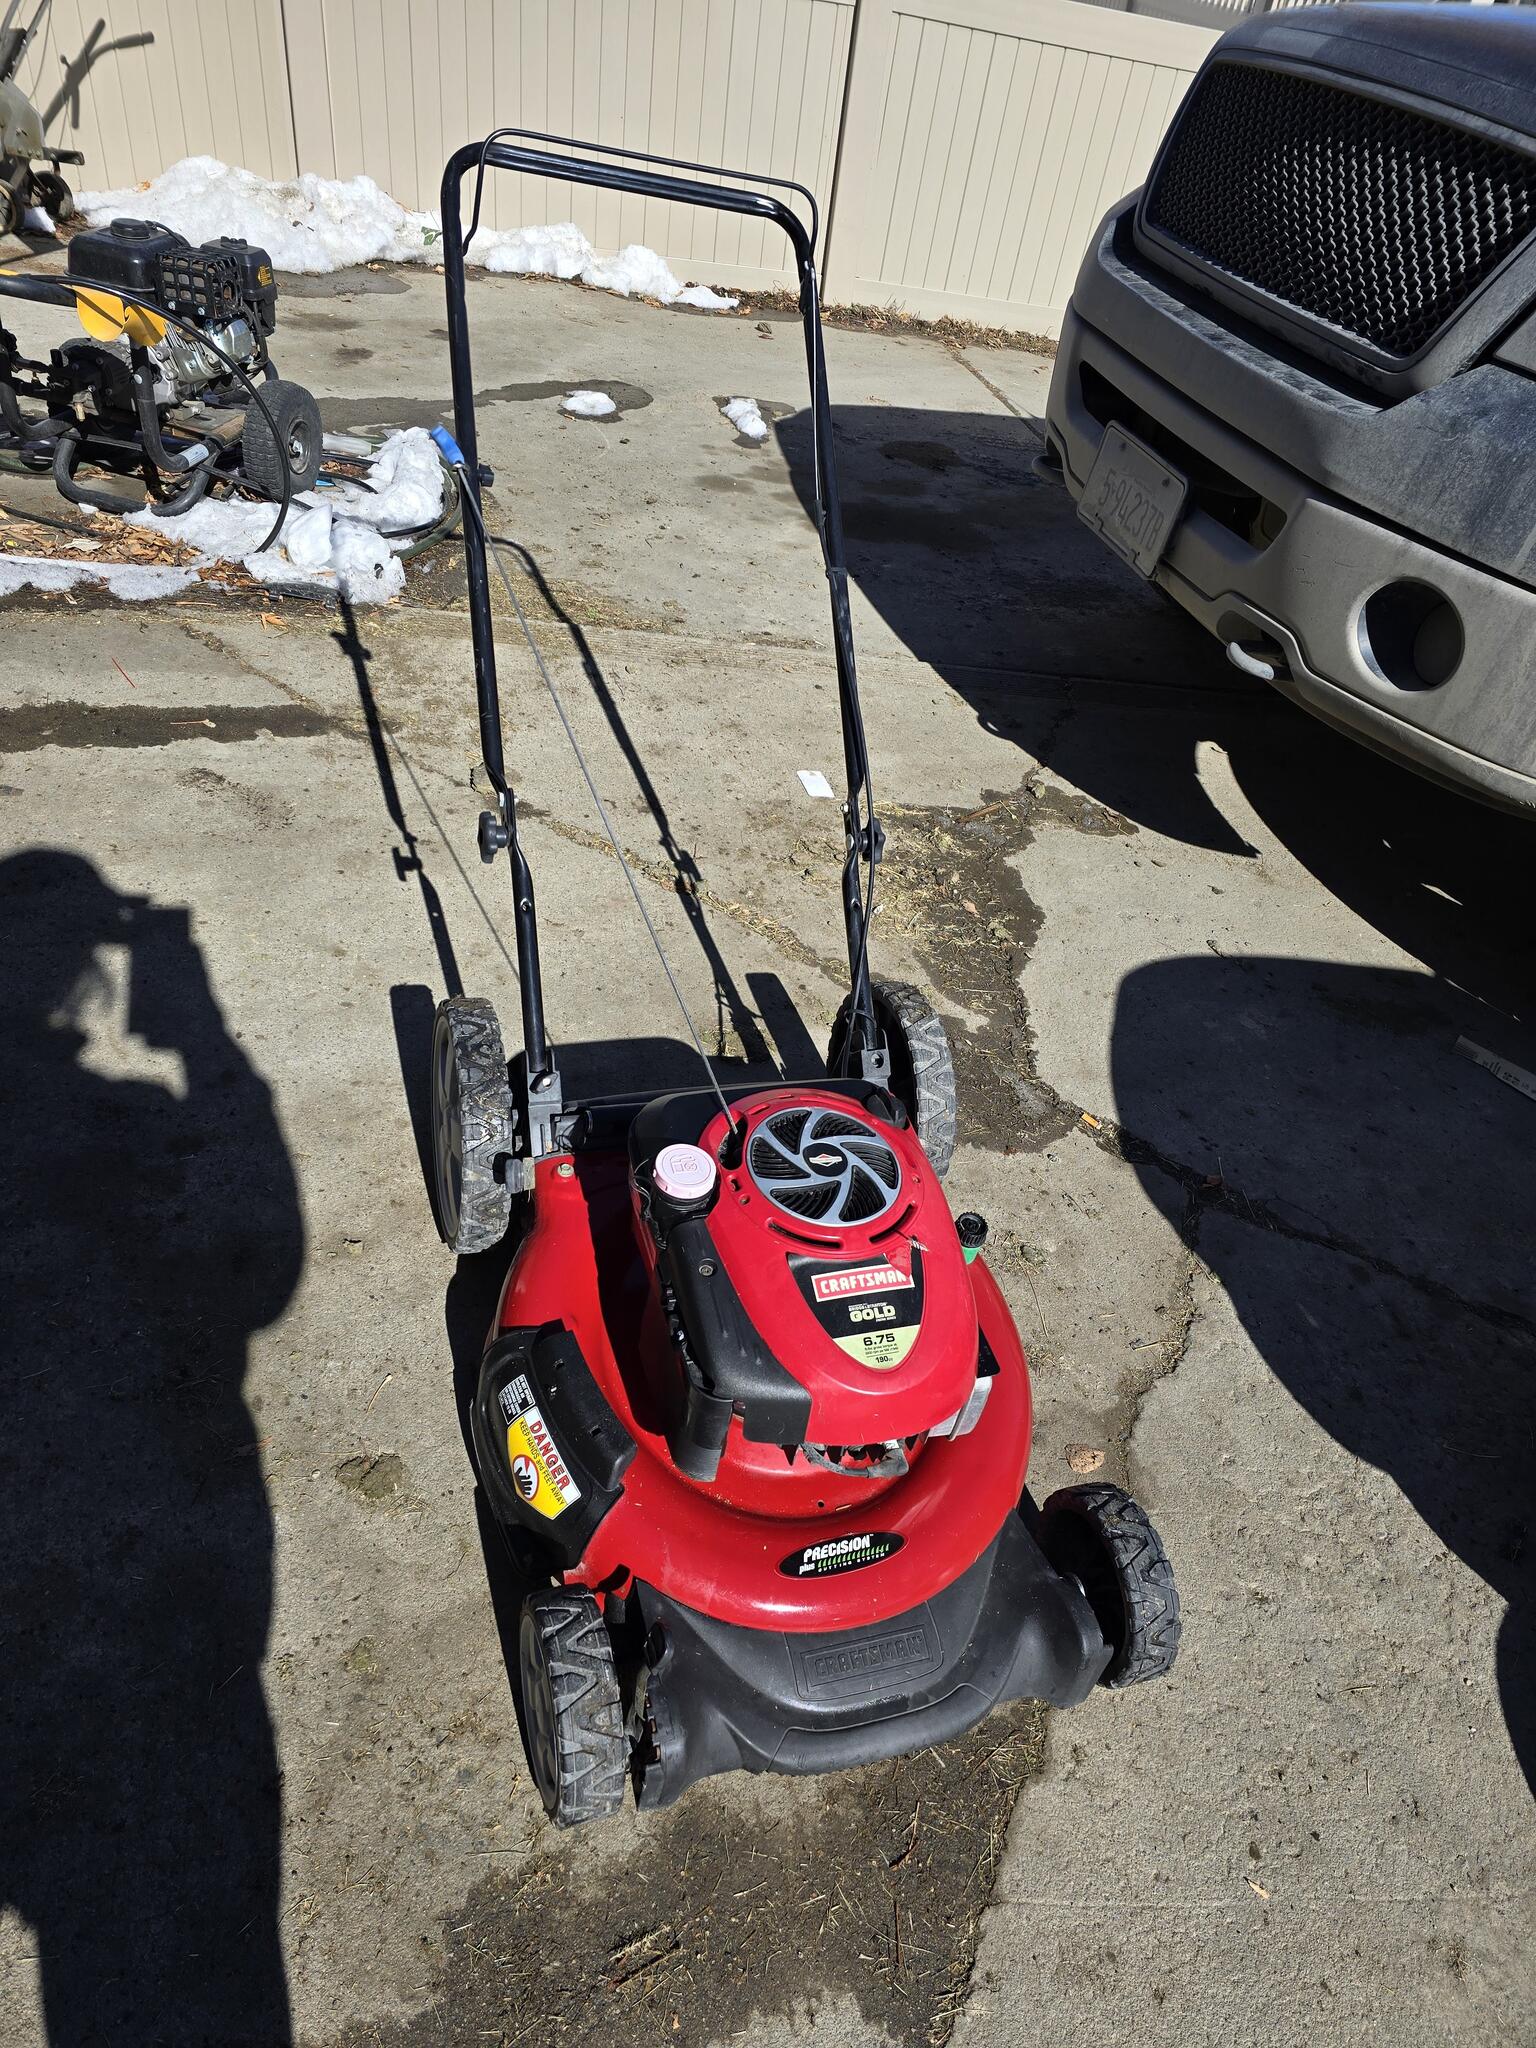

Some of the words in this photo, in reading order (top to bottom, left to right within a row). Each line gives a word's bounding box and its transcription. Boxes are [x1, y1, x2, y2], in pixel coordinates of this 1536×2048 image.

[820, 1269, 907, 1294] CRAFTSMAN
[849, 1305, 896, 1322] GOLD
[863, 1333, 896, 1346] 6.75
[520, 1421, 529, 1437] KEEP
[526, 1437, 540, 1460] HANDS
[535, 1459, 546, 1471] and
[543, 1468, 555, 1487] FEET
[550, 1486, 565, 1506] AWAY
[529, 1420, 571, 1491] DANGER
[803, 1534, 871, 1562] PRECISION
[799, 1562, 815, 1575] plus
